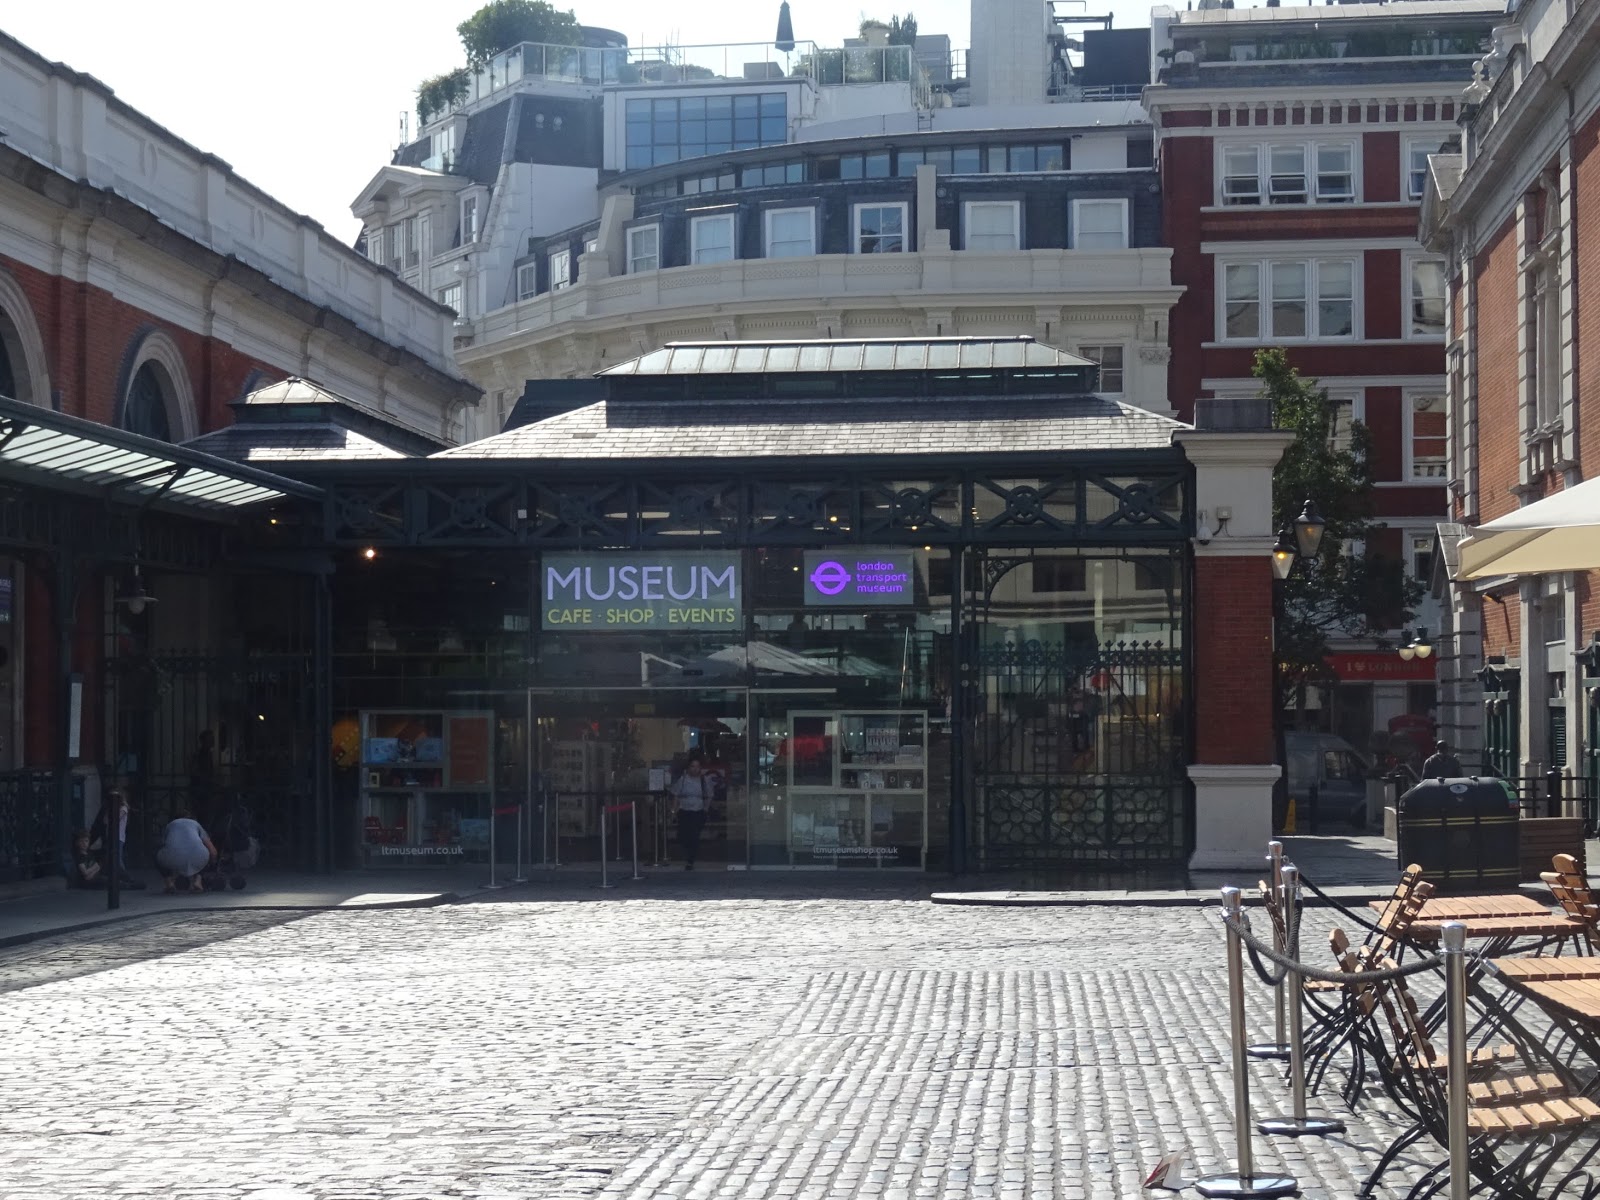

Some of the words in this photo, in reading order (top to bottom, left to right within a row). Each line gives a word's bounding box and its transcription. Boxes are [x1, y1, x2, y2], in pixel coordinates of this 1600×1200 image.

[856, 561, 894, 571] london
[547, 565, 736, 601] MUSEUM
[856, 573, 907, 583] transport
[856, 584, 903, 593] museum
[547, 608, 593, 624] CAFE
[606, 608, 654, 623] SHOP
[668, 608, 736, 623] EVENTS
[381, 845, 464, 855] ltmuseum.co.uk
[813, 846, 899, 855] ltmuseumshop.co.uk
